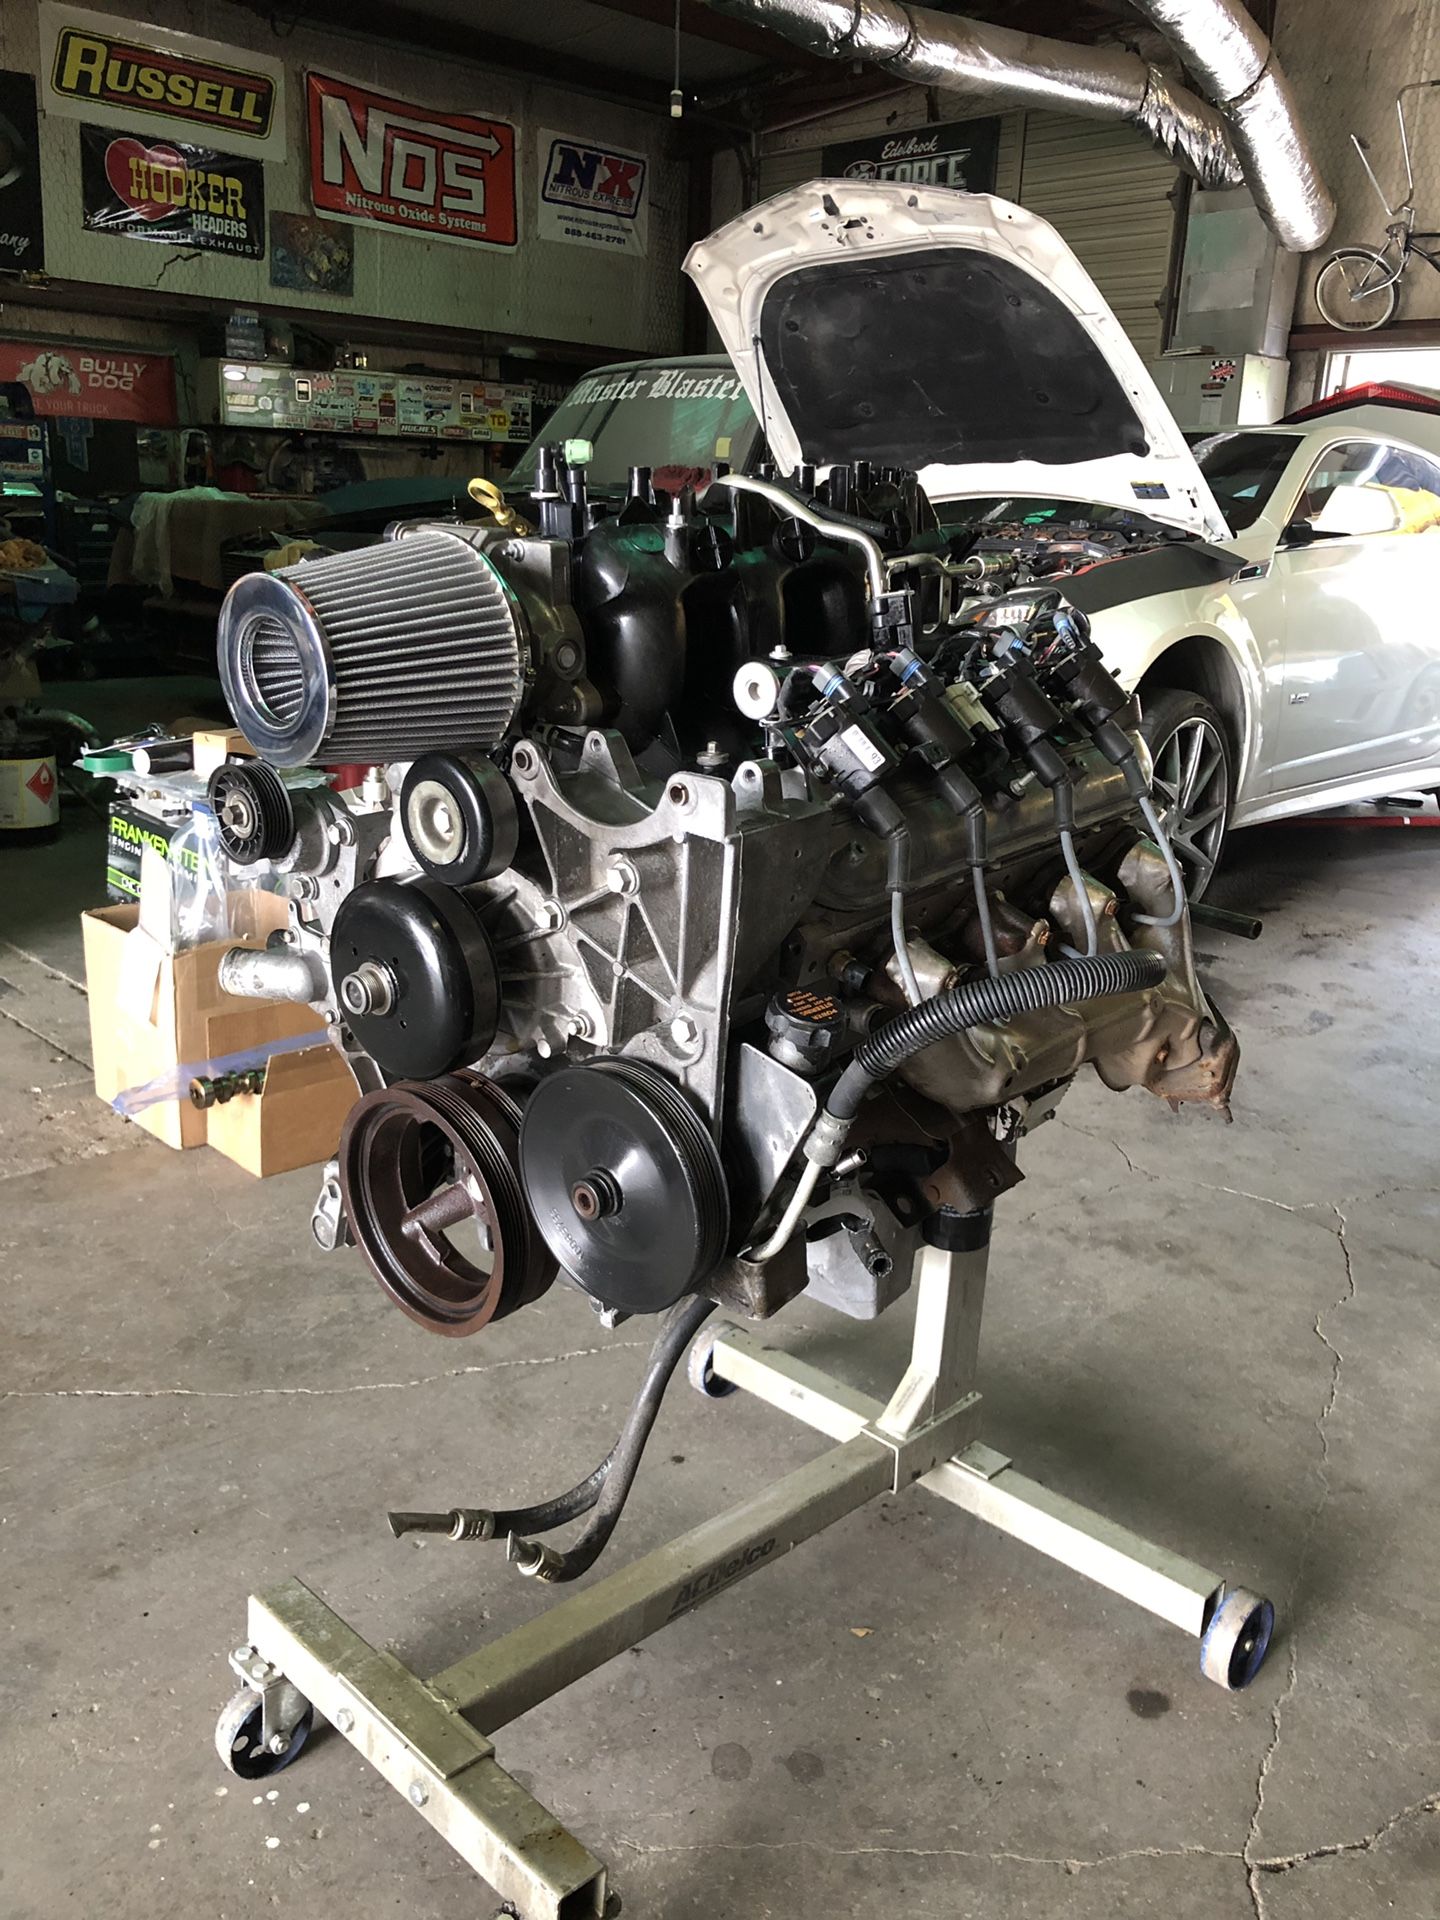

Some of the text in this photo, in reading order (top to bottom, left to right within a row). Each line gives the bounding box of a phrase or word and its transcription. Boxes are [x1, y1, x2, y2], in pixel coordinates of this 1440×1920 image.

[62, 36, 263, 124] RUSSELL
[322, 95, 500, 214] NOS
[881, 135, 939, 160] Edelbrock
[553, 149, 640, 199] NX
[128, 157, 247, 220] HOOKER
[550, 182, 590, 200] NITROUS
[593, 190, 635, 210] EXPRESS
[192, 213, 248, 239] HEADERS
[345, 191, 487, 234] Nitrous Oxide Systems
[200, 236, 260, 256] EXHAUST
[79, 357, 148, 378] BULLY
[88, 374, 135, 391] DOG
[567, 377, 648, 408] Master
[646, 369, 746, 401] Blaster
[112, 834, 142, 857] ENGIN
